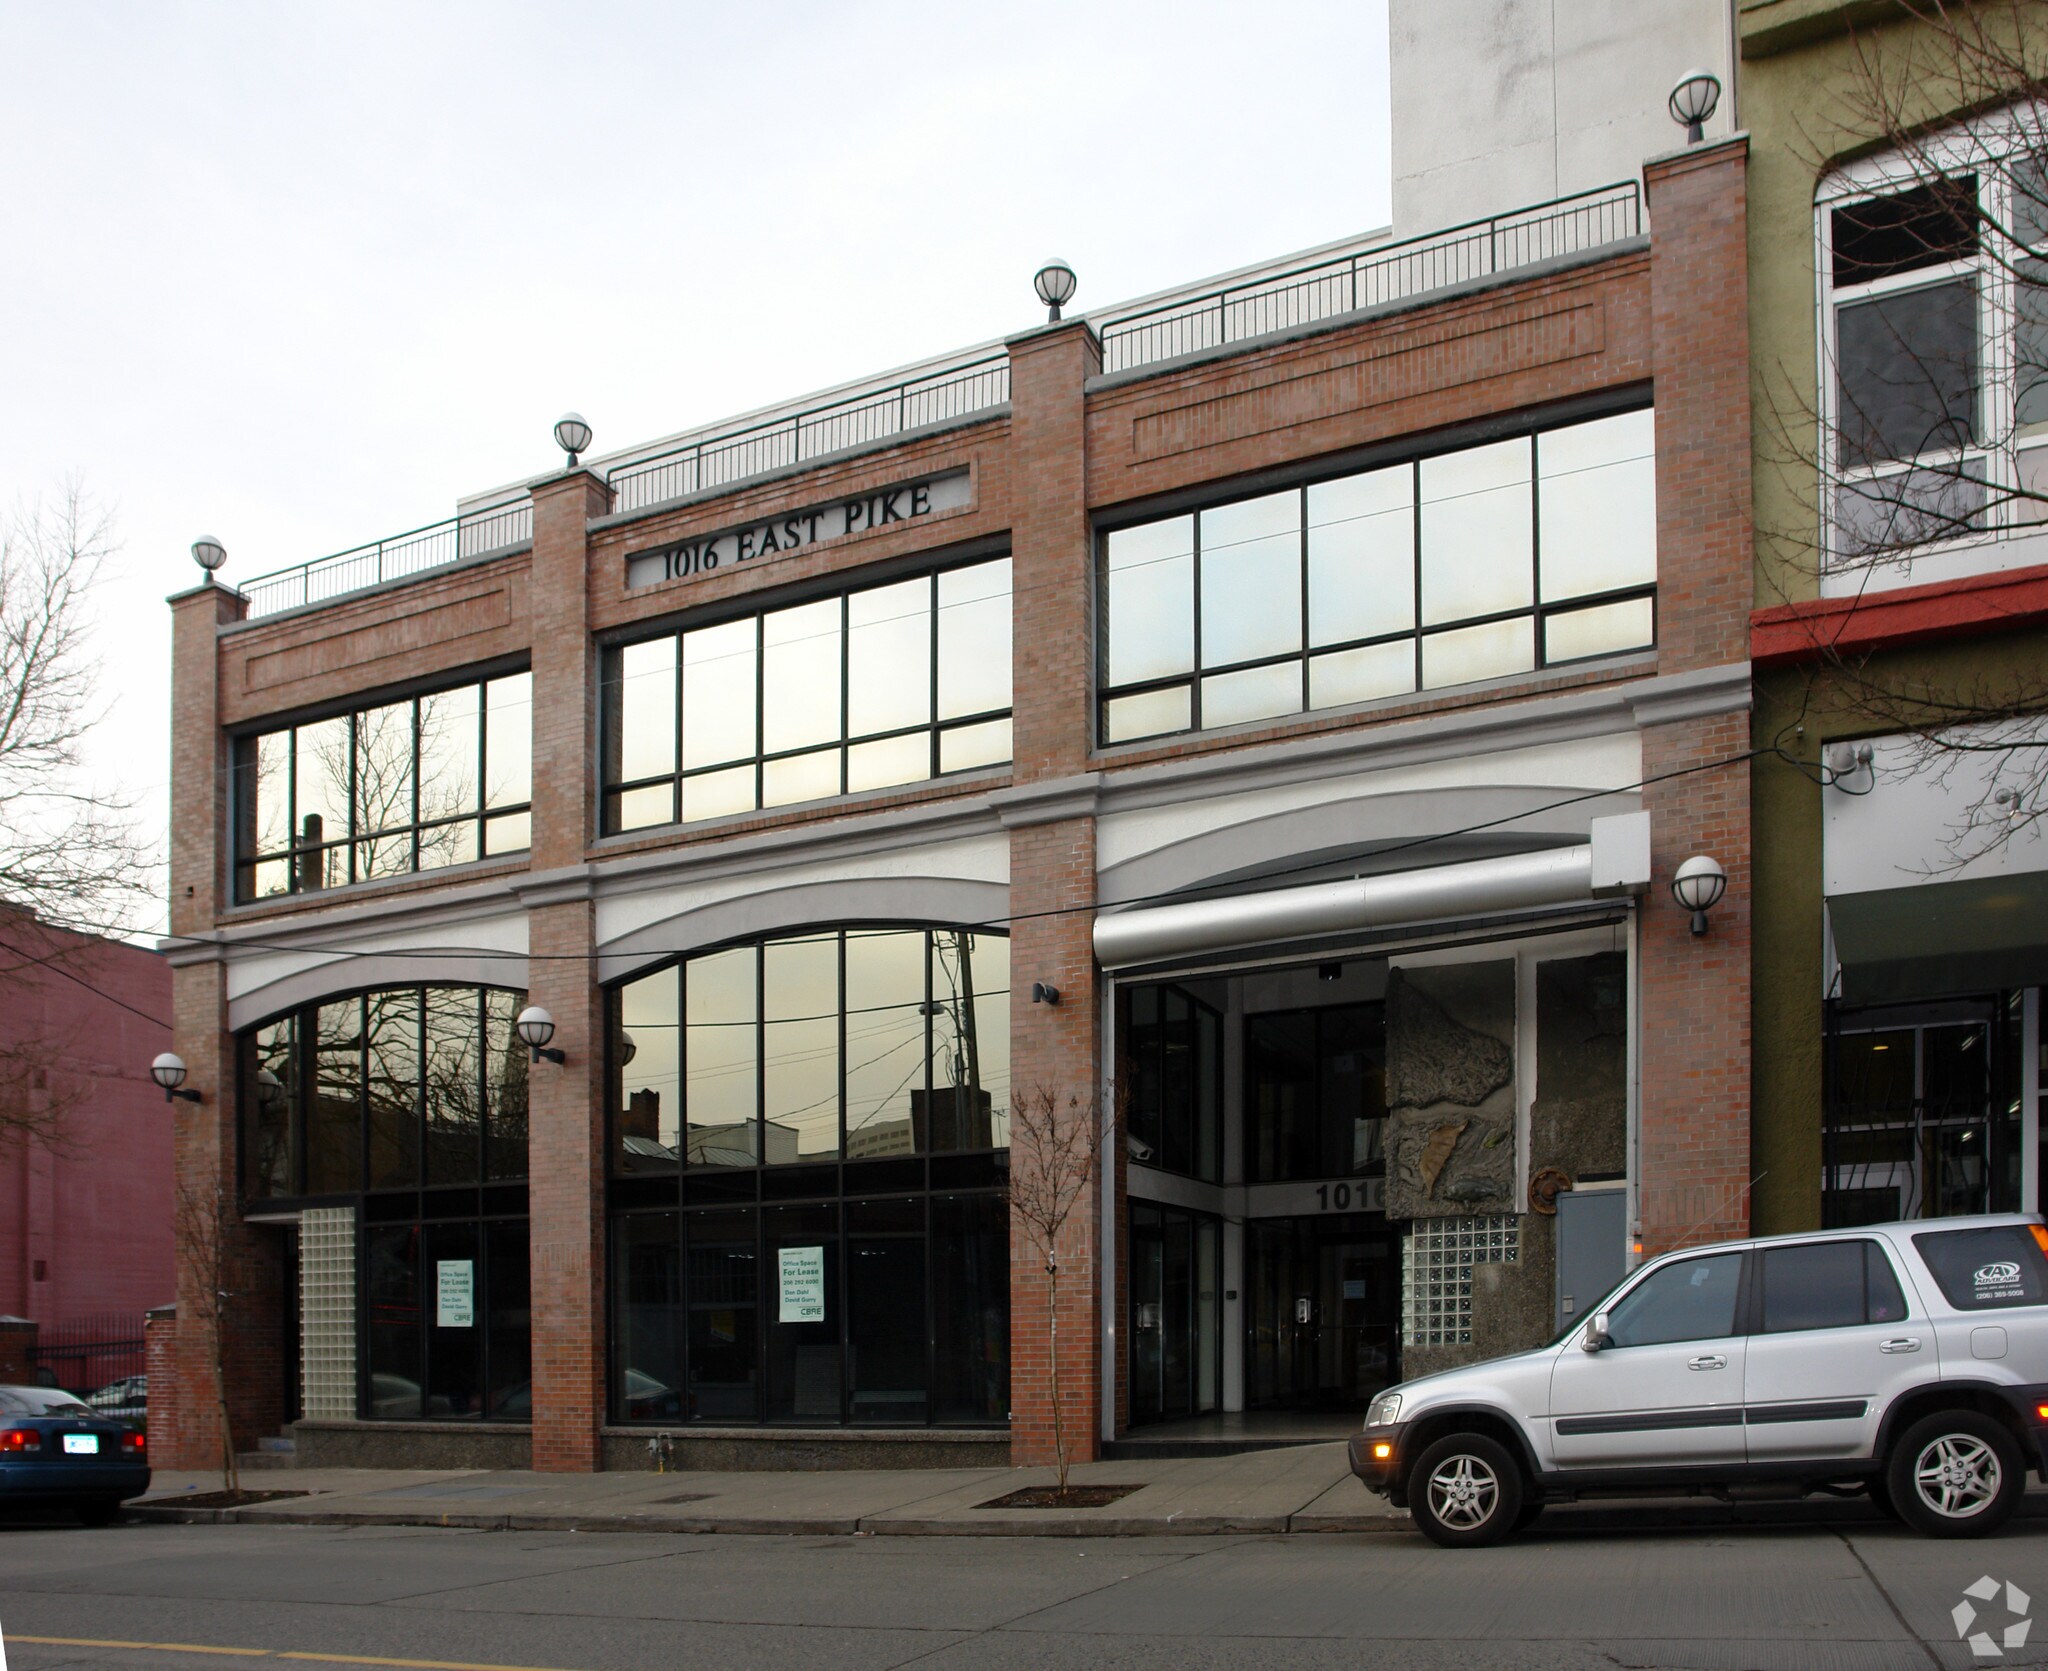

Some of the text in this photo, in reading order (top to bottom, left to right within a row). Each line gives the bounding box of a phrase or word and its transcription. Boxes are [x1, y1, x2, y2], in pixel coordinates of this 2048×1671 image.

[664, 483, 932, 581] 1016 EAST PIKE
